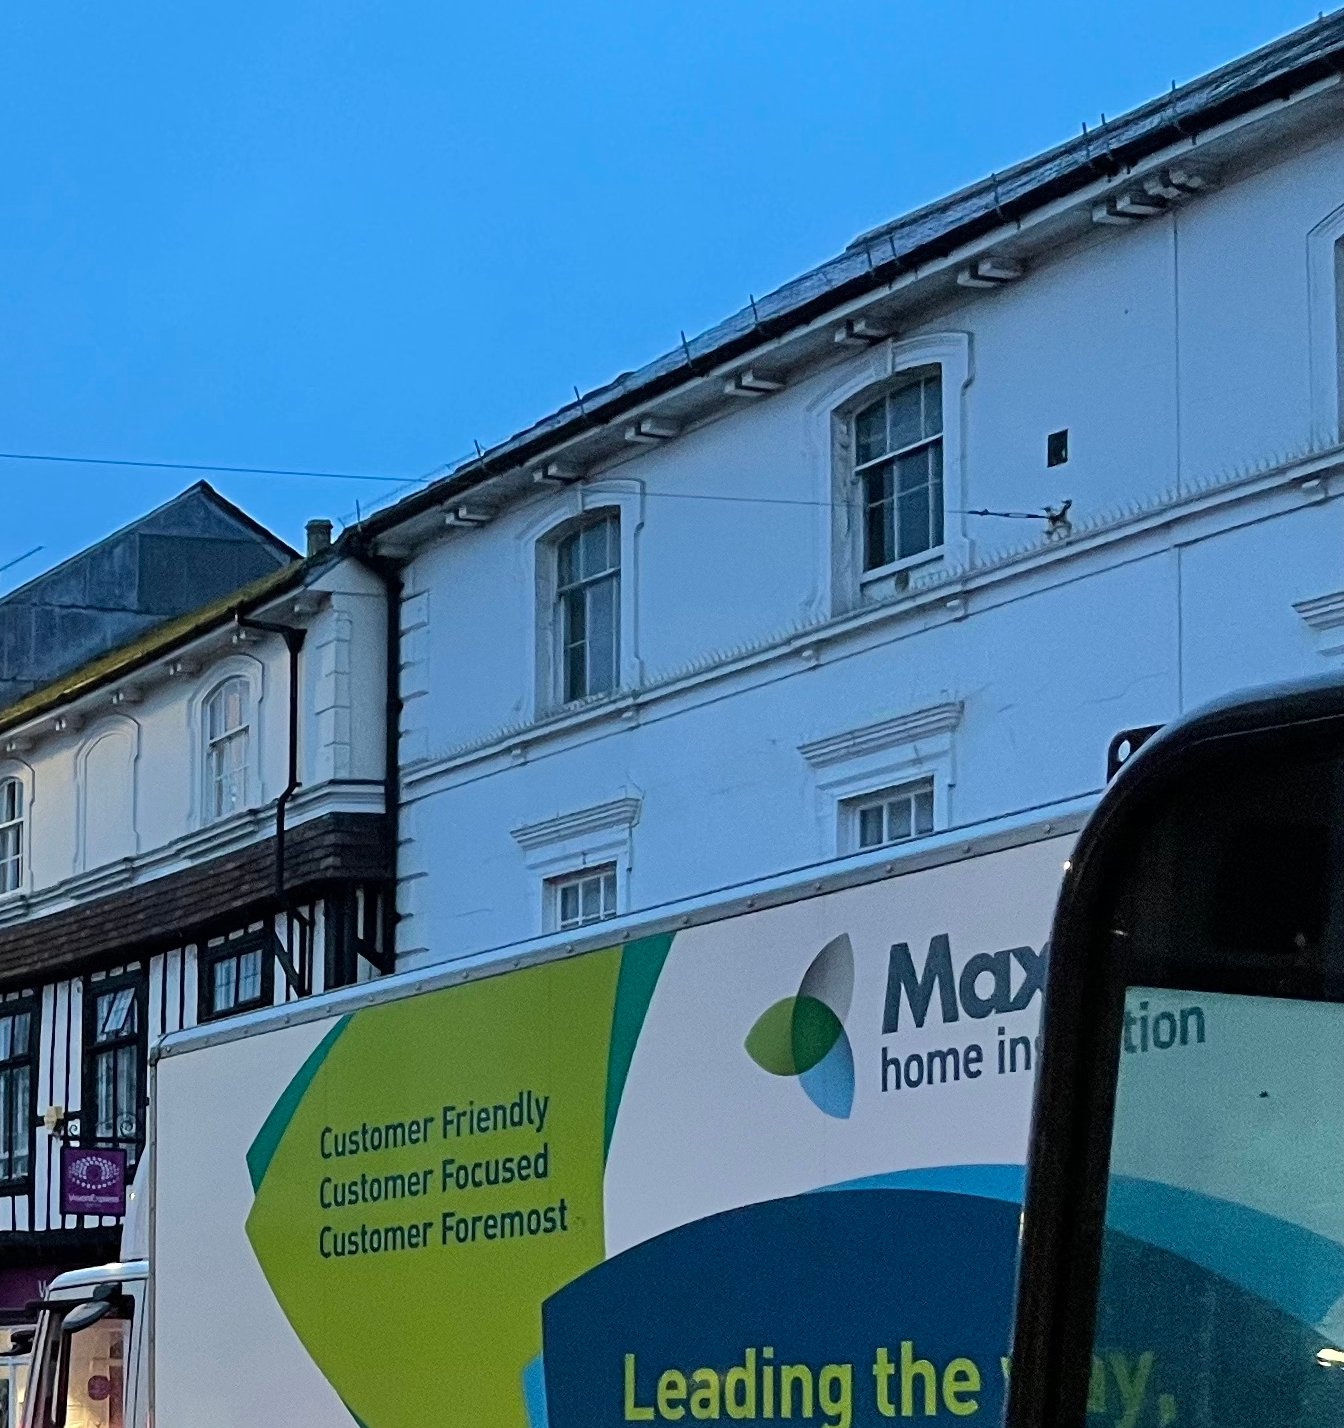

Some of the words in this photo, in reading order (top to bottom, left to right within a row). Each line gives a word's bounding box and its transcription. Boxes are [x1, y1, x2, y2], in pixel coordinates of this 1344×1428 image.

[881, 1044, 984, 1092] home
[320, 1116, 435, 1159] Customer
[442, 1089, 550, 1134] Friendly
[319, 1167, 434, 1209] Customer
[441, 1142, 549, 1193] Focused
[319, 1220, 434, 1259] Customer
[441, 1198, 568, 1246] Foremost
[872, 1340, 981, 1417] the
